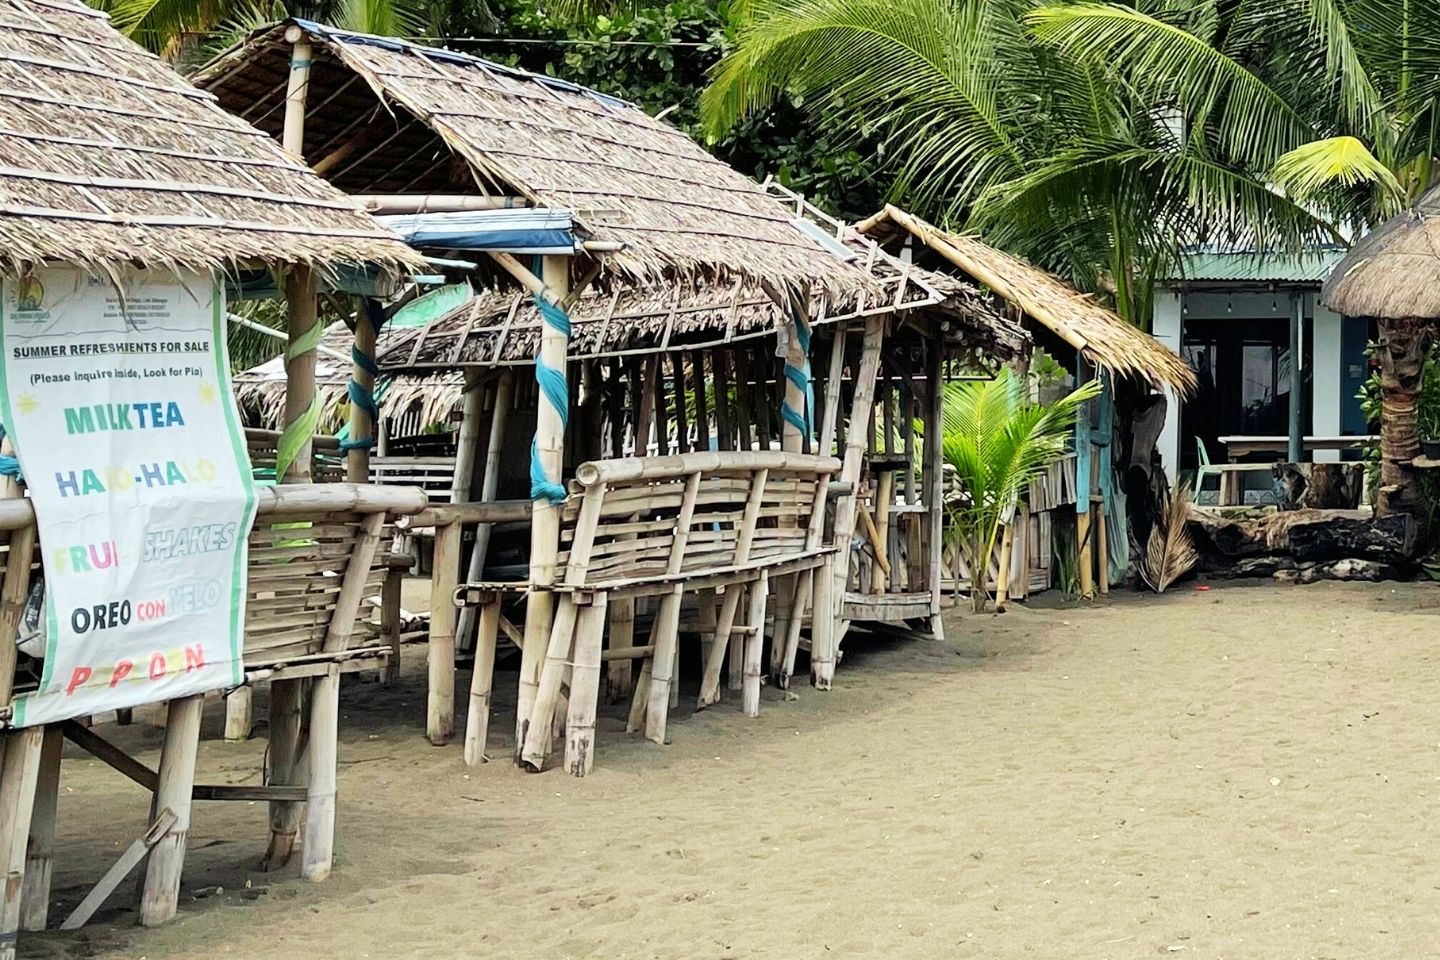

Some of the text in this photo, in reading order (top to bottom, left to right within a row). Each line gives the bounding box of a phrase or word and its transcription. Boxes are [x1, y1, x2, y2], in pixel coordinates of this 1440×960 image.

[13, 345, 66, 358] SUMMER
[160, 342, 181, 352] FOR
[184, 341, 209, 352] SALE
[30, 373, 71, 387] (Please
[74, 370, 112, 383] inquire
[143, 368, 166, 378] Look
[169, 367, 182, 377] for
[143, 522, 237, 563] SHAKES
[71, 599, 132, 634] OREO
[136, 598, 167, 621] CON
[168, 579, 222, 613] YELO
